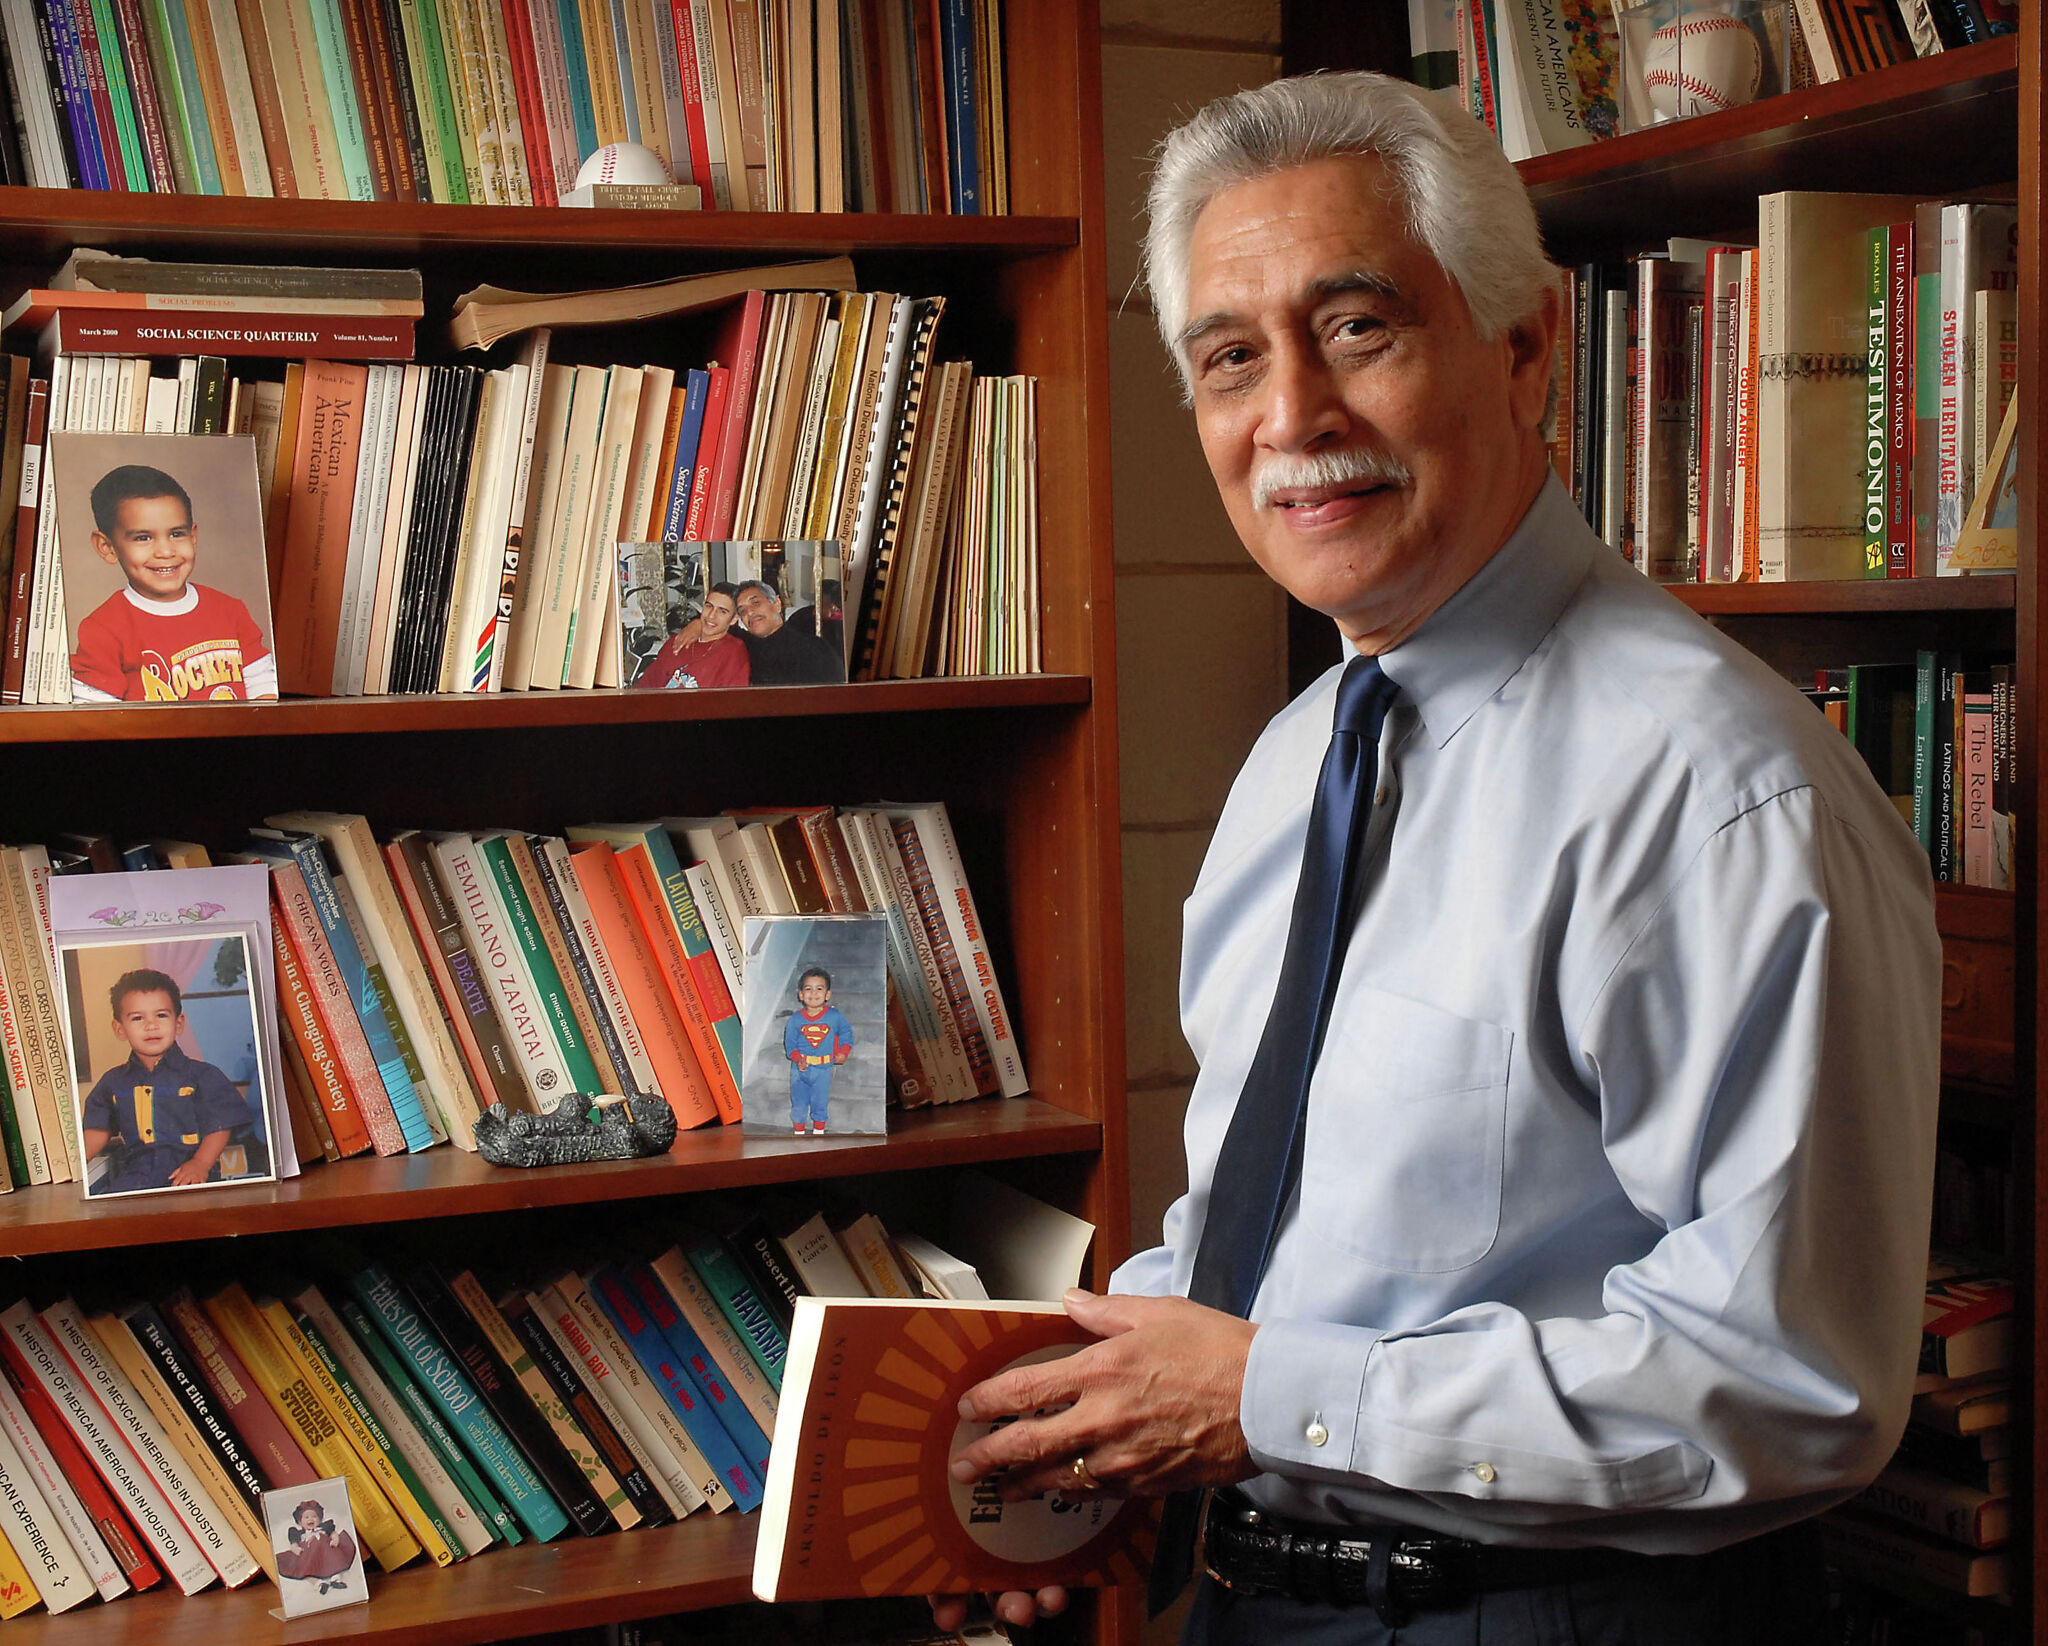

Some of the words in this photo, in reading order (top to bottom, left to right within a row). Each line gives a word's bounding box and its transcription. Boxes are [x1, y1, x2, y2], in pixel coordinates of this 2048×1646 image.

[675, 8, 685, 37] CHICANO
[681, 8, 694, 57] INTERNATIONAL
[679, 38, 689, 68] STUDIES
[682, 67, 693, 104] RESEARCH
[688, 62, 698, 92] JOURNAL
[692, 93, 699, 103] OF
[1532, 46, 1545, 69] AND
[1540, 74, 1557, 112] FUTURE
[1547, 35, 1579, 128] AMERICANS
[152, 134, 161, 154] FALL
[307, 124, 321, 155] SPRING
[316, 166, 326, 185] FALL
[372, 139, 386, 173] SUMMER
[379, 174, 389, 192] 1975
[1872, 242, 1880, 293] ROSALES
[1896, 244, 1904, 273] THE
[1727, 299, 1736, 334] Politics
[1748, 260, 1759, 327] COMMUNITY
[79, 327, 100, 336] March
[102, 328, 118, 336] 2000
[137, 328, 184, 338] SOCIAL
[187, 330, 241, 340] SCIENCE
[244, 331, 318, 342] QUARTERLY
[358, 334, 366, 342] 81,
[1727, 335, 1735, 347] of
[1896, 277, 1904, 367] ANNEXATION
[740, 349, 752, 382] CHICANO
[1726, 348, 1735, 392] Chicano
[1942, 311, 1956, 386] STOLEN
[734, 384, 746, 418] WORKERS
[863, 370, 877, 407] National
[1739, 367, 1748, 408] COLD
[1747, 339, 1756, 421] EMPOWERMENT
[1896, 371, 1903, 389] OF
[321, 399, 354, 476] Mexican
[855, 410, 871, 449] Directory
[1725, 394, 1734, 446] Liberation
[1867, 301, 1884, 532] TESTIMONIO
[1895, 393, 1903, 448] MEXICO
[299, 396, 334, 494] Americans
[854, 455, 863, 464] of
[1736, 413, 1747, 468] ANGER
[1745, 438, 1754, 486] CHICANO
[1940, 398, 1956, 493] HERITAGE
[23, 462, 34, 493] REDEN
[676, 466, 689, 496] Social
[694, 465, 709, 494] Social
[848, 467, 861, 504] Chicano
[670, 497, 684, 532] Science
[688, 495, 703, 530] Science
[840, 507, 854, 540] Faculty
[1743, 491, 1752, 569] SCHOLARSHIP
[141, 650, 242, 700] ROCKET
[1914, 735, 1925, 779] Latino
[1943, 743, 1951, 789] LATINOS
[1971, 724, 1986, 763] The
[1999, 747, 2006, 758] IN
[1991, 754, 1999, 781] LAND
[1941, 792, 1949, 811] AND
[1969, 773, 1985, 829] Rebel
[1939, 814, 1949, 867] POLITICAL
[498, 859, 511, 883] Bernal
[506, 884, 517, 899] and
[512, 899, 526, 925] Knight,
[523, 926, 536, 951] editors
[535, 845, 550, 876] Feminist
[546, 877, 560, 903] Family
[557, 904, 571, 930] Values
[567, 931, 580, 955] Forum
[666, 873, 699, 930] LATINOS
[892, 866, 914, 910] MEXICAN
[901, 833, 926, 881] Nuevos
[920, 884, 942, 942] Senderos
[952, 886, 981, 943] MUSEUM
[294, 893, 321, 951] CHICANA
[318, 952, 340, 996] VOICES
[907, 911, 933, 966] AMERICANS
[285, 962, 298, 976] in
[291, 980, 301, 991] a
[453, 956, 487, 1016] DEATH
[582, 919, 598, 948] FROM
[594, 949, 617, 997] RHETORIC
[612, 999, 624, 1014] TO
[619, 1015, 640, 1056] REALITY
[925, 968, 937, 978] IN
[928, 977, 940, 987] A
[971, 950, 994, 988] MAYA
[293, 992, 327, 1061] Changing
[499, 974, 544, 1059] ZAPATA!
[549, 993, 563, 1018] ETHNIC
[560, 1019, 575, 1047] IDENTITY
[931, 988, 951, 1022] DALLAS
[981, 987, 1010, 1040] CULTURE
[1, 1011, 17, 1047] SOCIAL
[944, 1022, 961, 1055] BARRIO
[8, 1048, 26, 1091] SCIENCE
[318, 1060, 347, 1111] Society
[29, 1143, 44, 1175] PRAEGER
[755, 1239, 788, 1286] Desert
[368, 1281, 405, 1324] Tales
[396, 1315, 426, 1350] Out
[557, 1317, 594, 1353] BARRIO
[586, 1354, 610, 1380] BOY
[730, 1288, 783, 1367] HAVANA
[415, 1341, 439, 1367] of
[146, 1323, 163, 1348] The
[161, 1348, 189, 1385] Power
[186, 1385, 208, 1415] Elite
[205, 1415, 226, 1440] and
[220, 1438, 240, 1462] the
[234, 1459, 263, 1495] State
[289, 1378, 338, 1439] CHICANO
[426, 1358, 474, 1415] School
[14, 1321, 26, 1333] A
[21, 1331, 57, 1375] HISTORY
[52, 1376, 69, 1393] OF
[63, 1391, 99, 1438] MEXICAN
[95, 1439, 139, 1496] AMERICANS
[134, 1495, 147, 1508] IN
[143, 1507, 180, 1556] HOUSTON
[59, 1315, 71, 1327] A
[65, 1325, 100, 1369] HISTORY
[95, 1370, 112, 1386] OF
[107, 1385, 142, 1431] MEXICAN
[138, 1432, 182, 1489] AMERICANS
[178, 1488, 190, 1501] IN
[185, 1500, 223, 1548] HOUSTON
[277, 1390, 324, 1448] STUDIES
[339, 1381, 354, 1396] THE
[347, 1393, 370, 1419] FUTURE
[364, 1416, 374, 1426] IS
[370, 1423, 390, 1450] MESTIZO
[402, 1383, 437, 1423] Understanding
[430, 1421, 447, 1440] Older
[440, 1436, 464, 1463] Chicanas
[799, 1451, 828, 1570] ARNOLDO
[817, 1412, 834, 1440] DE
[13, 1500, 58, 1572] EXPERIENCE
[432, 1517, 462, 1556] CROSSROAD
